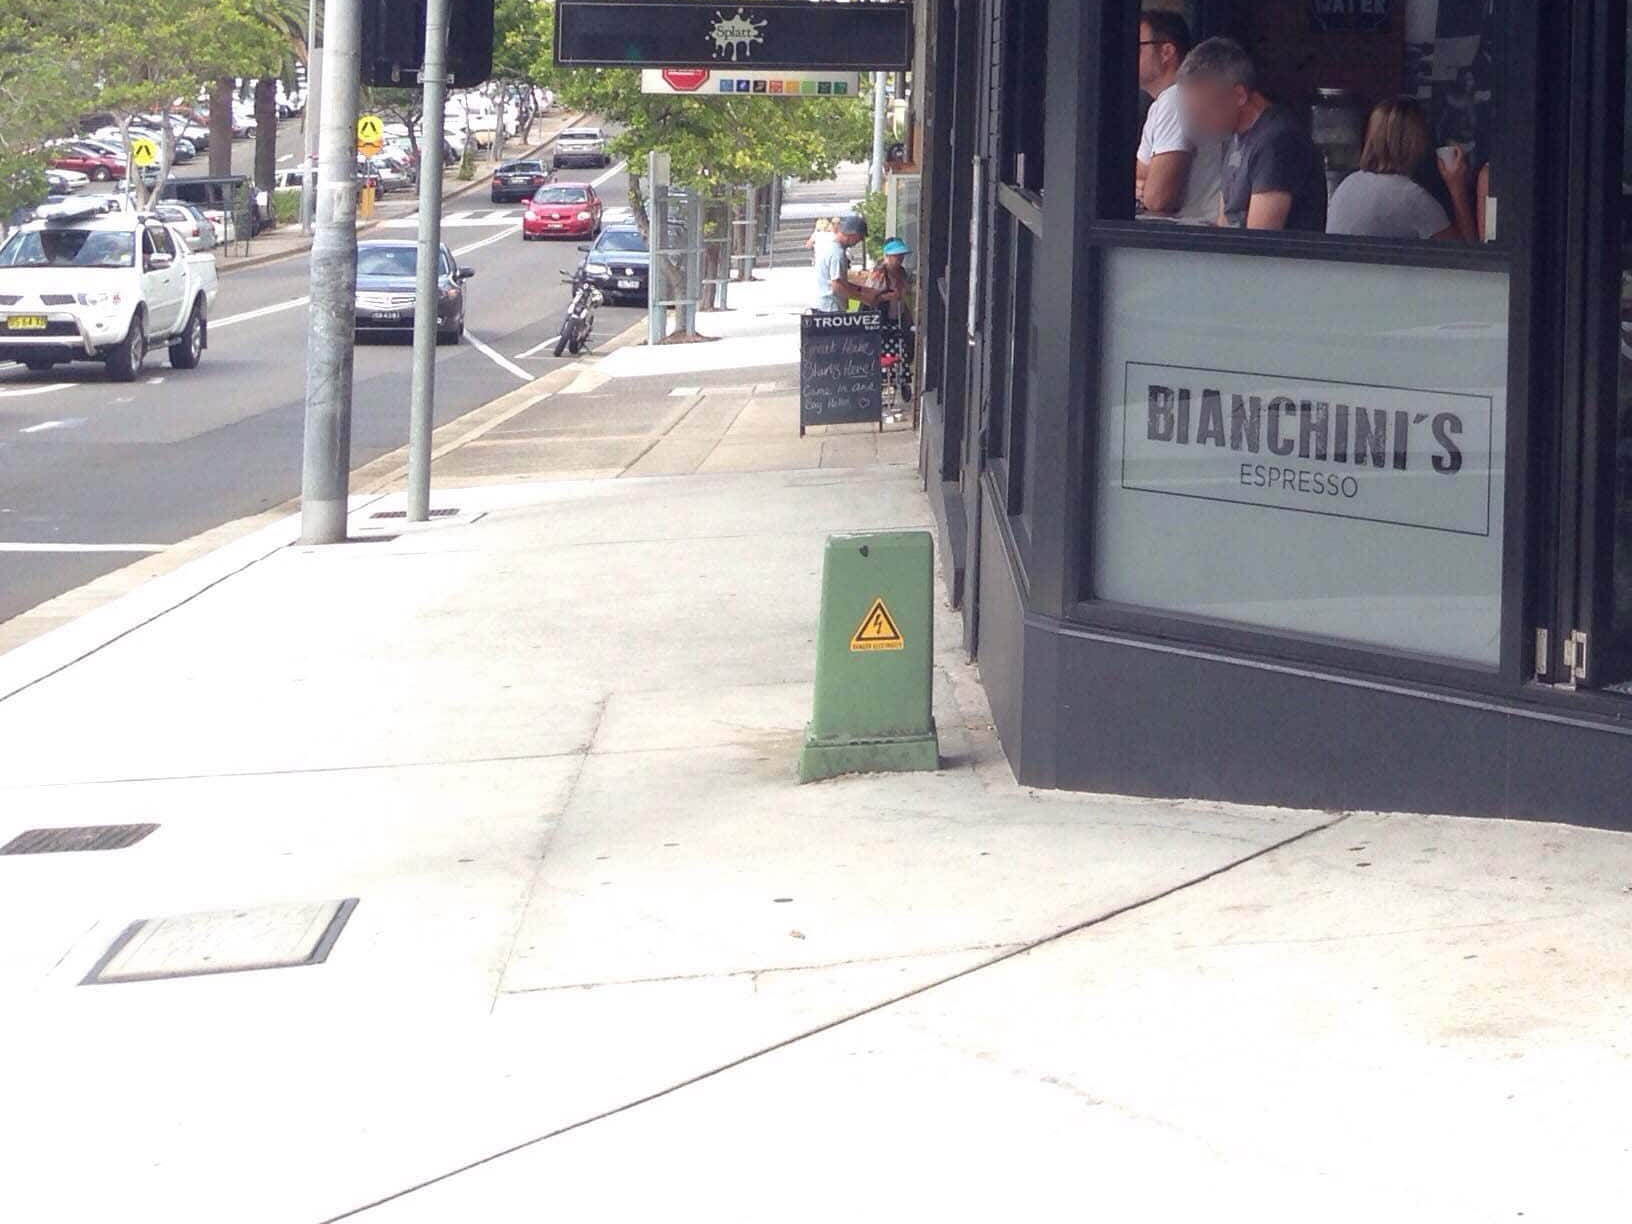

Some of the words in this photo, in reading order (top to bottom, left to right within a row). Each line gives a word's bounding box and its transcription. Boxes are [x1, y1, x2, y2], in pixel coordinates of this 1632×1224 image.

[814, 315, 880, 328] TROUVEZ
[1146, 383, 1463, 475] BIANCHINI'S
[1239, 462, 1359, 499] ESPRESSO
